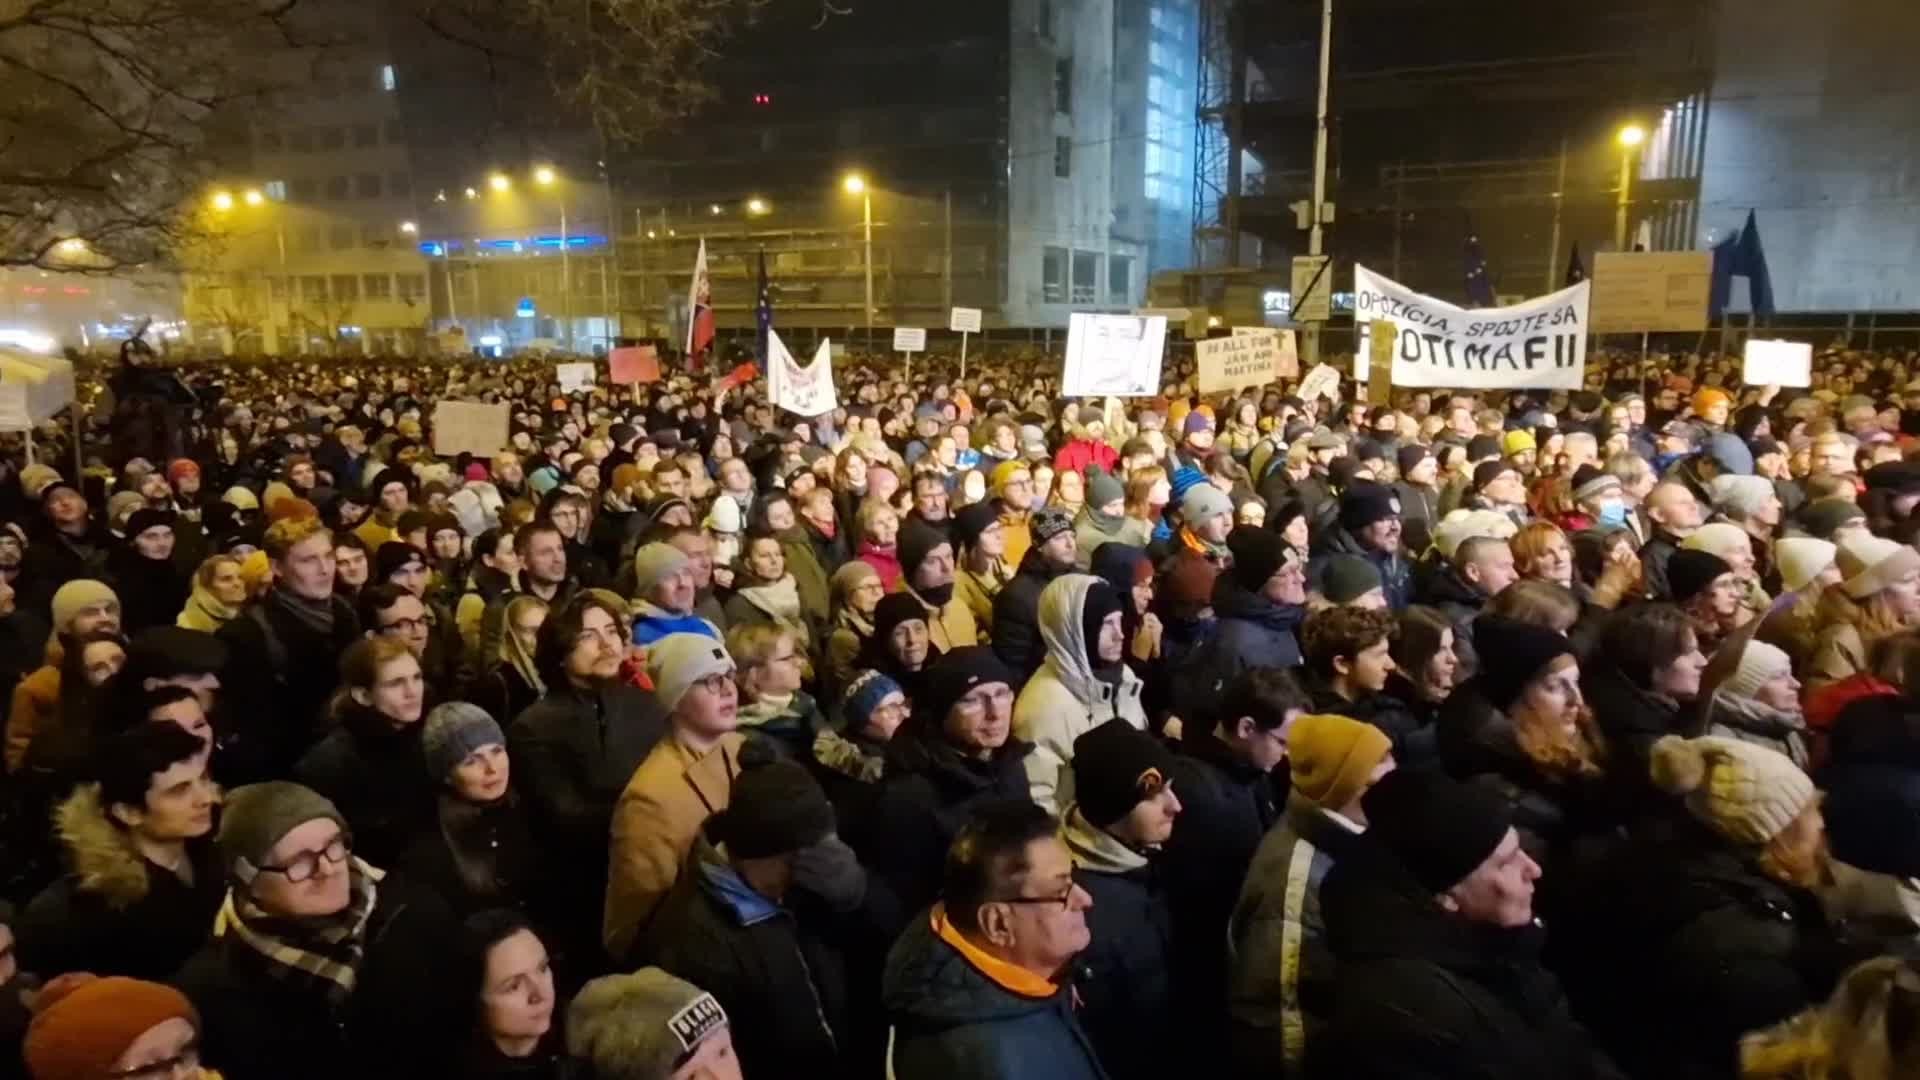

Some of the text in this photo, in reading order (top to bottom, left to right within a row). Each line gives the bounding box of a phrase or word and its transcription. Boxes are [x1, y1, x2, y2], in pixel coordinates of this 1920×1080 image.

[1464, 312, 1549, 337] SPOJTE
[1551, 304, 1577, 325] SA
[1354, 321, 1576, 370] POTI MAFII
